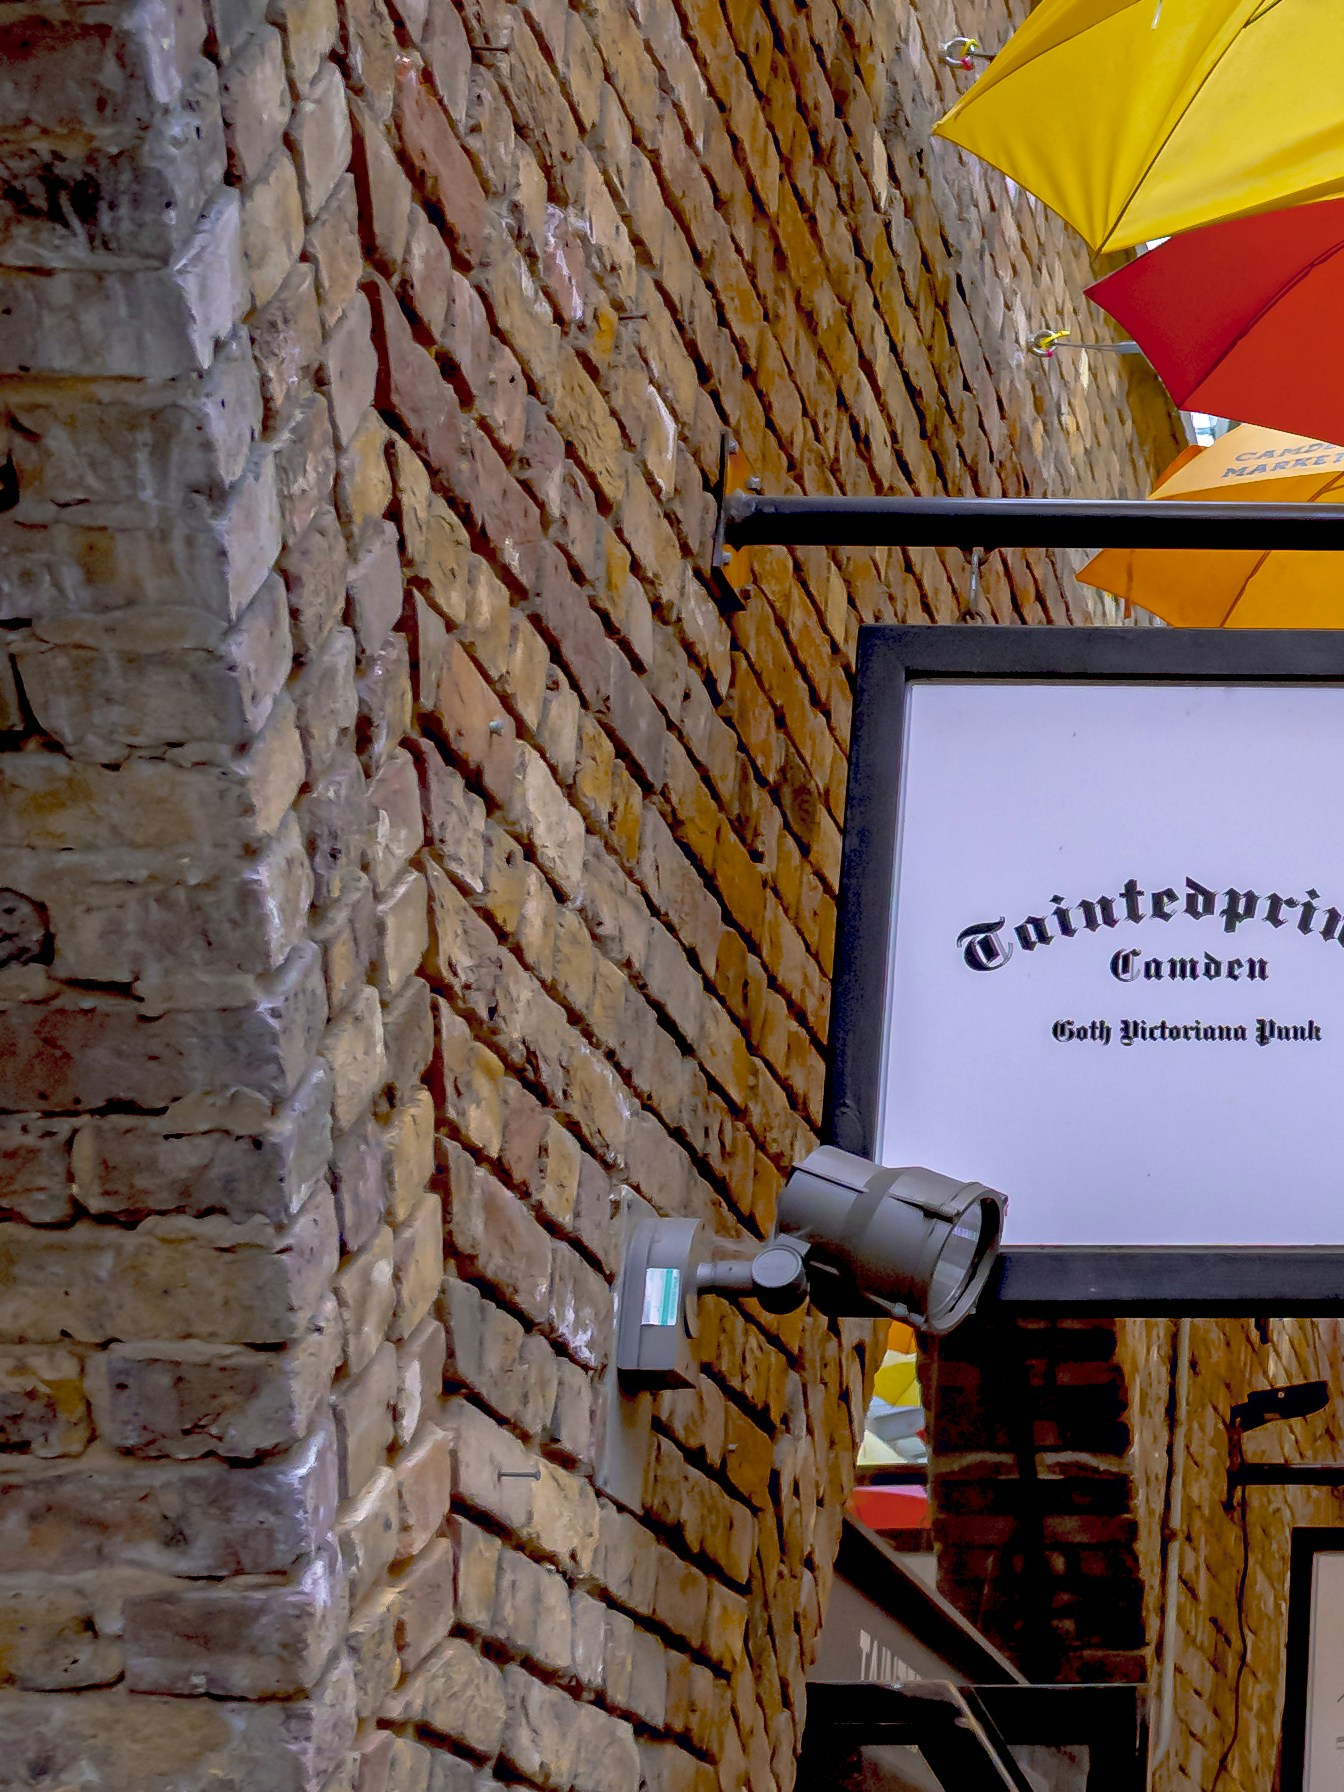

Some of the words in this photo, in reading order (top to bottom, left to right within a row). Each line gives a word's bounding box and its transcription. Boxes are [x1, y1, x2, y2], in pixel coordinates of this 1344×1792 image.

[1109, 947, 1270, 983] Camden
[1052, 1018, 1112, 1046] Goth
[1255, 1017, 1323, 1047] Punk
